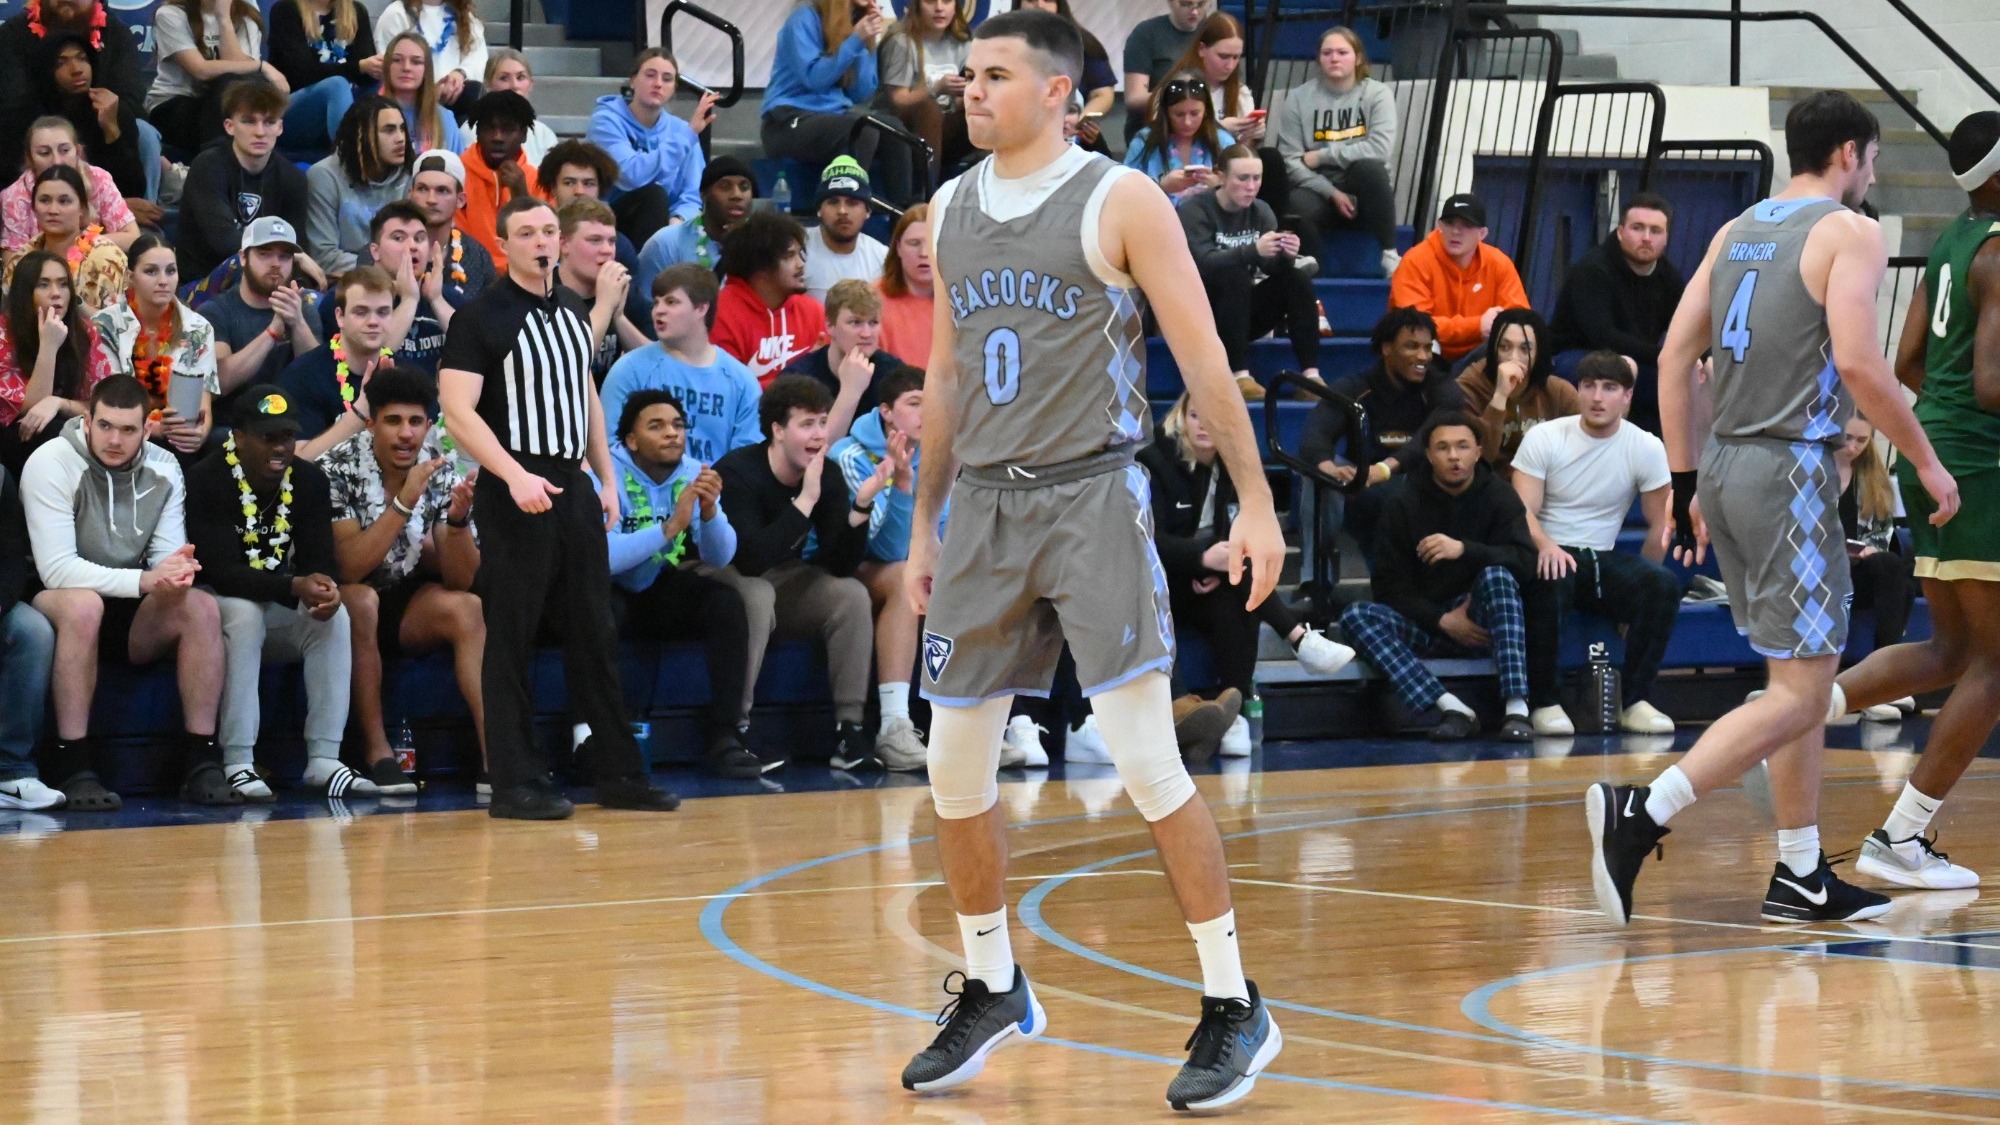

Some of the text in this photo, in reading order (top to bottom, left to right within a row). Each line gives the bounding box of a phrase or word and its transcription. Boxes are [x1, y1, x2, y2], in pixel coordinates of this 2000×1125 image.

[1313, 106, 1367, 132] IOWA
[1727, 241, 1777, 262] HRNCIR
[950, 267, 1085, 330] EACOCKS
[1720, 268, 1760, 364] 4
[1931, 262, 1953, 339] 0
[758, 334, 795, 360] NIKE
[983, 326, 1022, 406] 0
[662, 384, 725, 418] PPER
